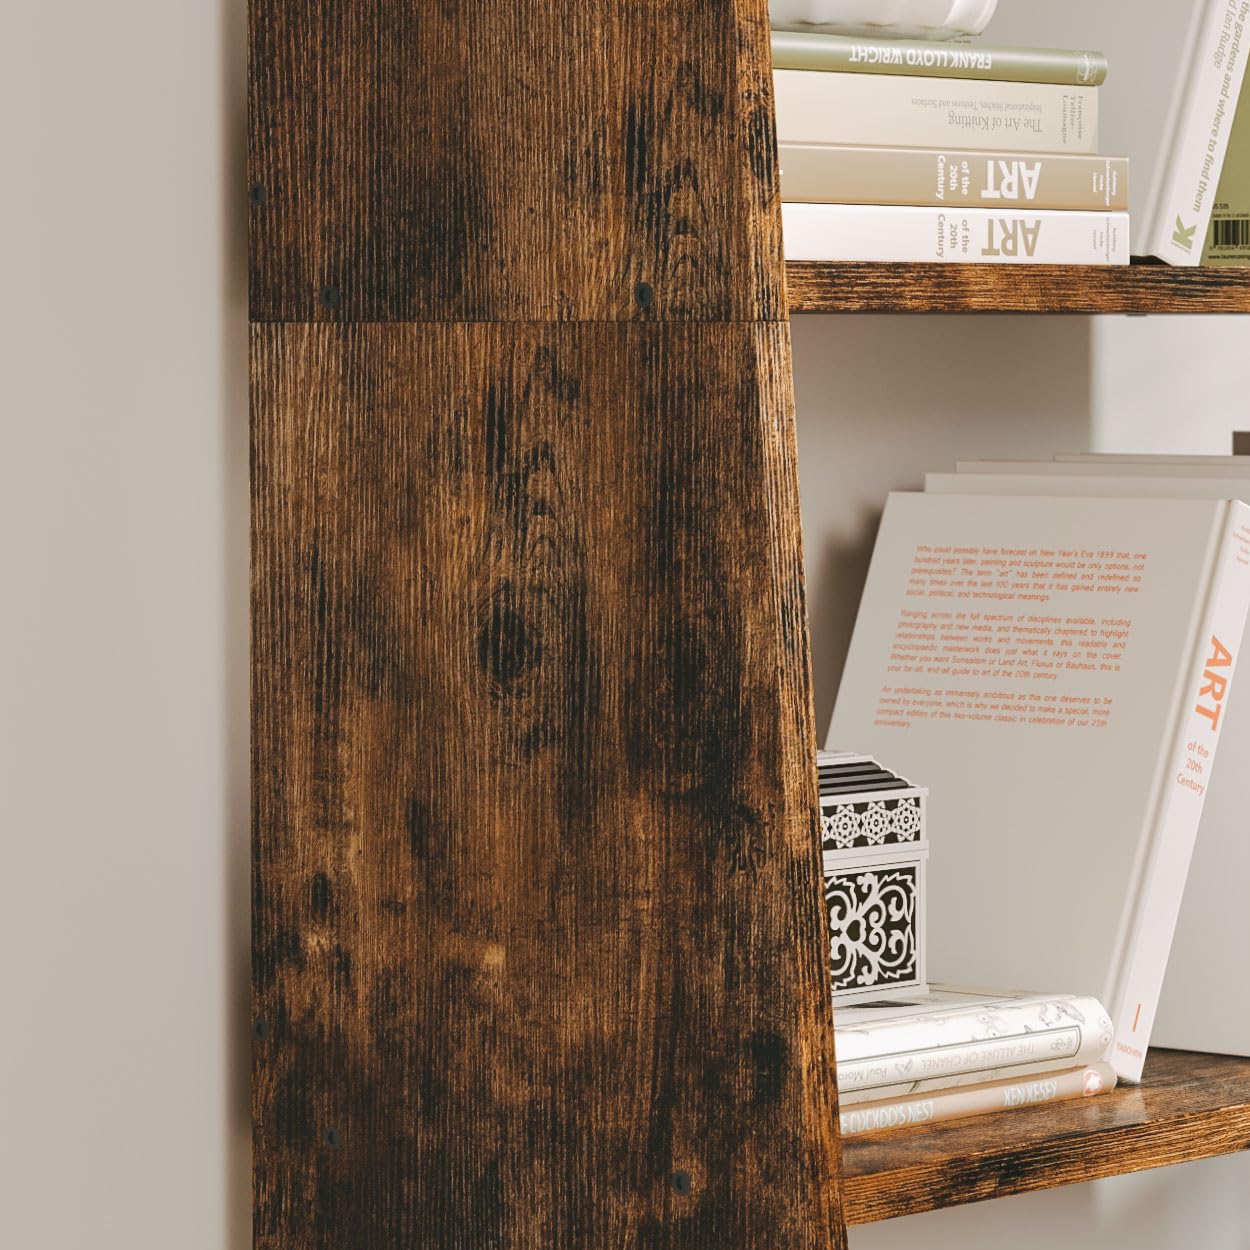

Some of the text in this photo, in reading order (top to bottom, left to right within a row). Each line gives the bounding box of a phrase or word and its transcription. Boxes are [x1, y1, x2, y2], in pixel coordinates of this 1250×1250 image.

[1223, 10, 1236, 30] Ian
[849, 45, 992, 69] FRANK LLOYD WRIGHT
[1213, 30, 1231, 70] Rudge
[1226, 22, 1244, 74] gardens
[1220, 73, 1232, 99] and
[948, 111, 1043, 133] The Art of Knitting
[1211, 98, 1226, 138] where
[1207, 138, 1218, 152] to
[936, 155, 946, 200] Century
[949, 164, 959, 191] 20th
[961, 161, 971, 196] of the
[981, 160, 1042, 200] ART
[1201, 153, 1215, 180] find
[1193, 179, 1208, 213] them
[936, 214, 946, 258] Century
[949, 223, 958, 249] 20th
[961, 219, 970, 253] of the
[981, 218, 1042, 256] ART
[1195, 635, 1233, 732] ART
[1187, 741, 1210, 759] of the
[1185, 758, 1203, 775] 20th
[1176, 773, 1206, 797] Century
[838, 1068, 864, 1083] Mora
[1003, 1084, 1026, 1106] KEN
[1027, 1079, 1057, 1103] KESEY
